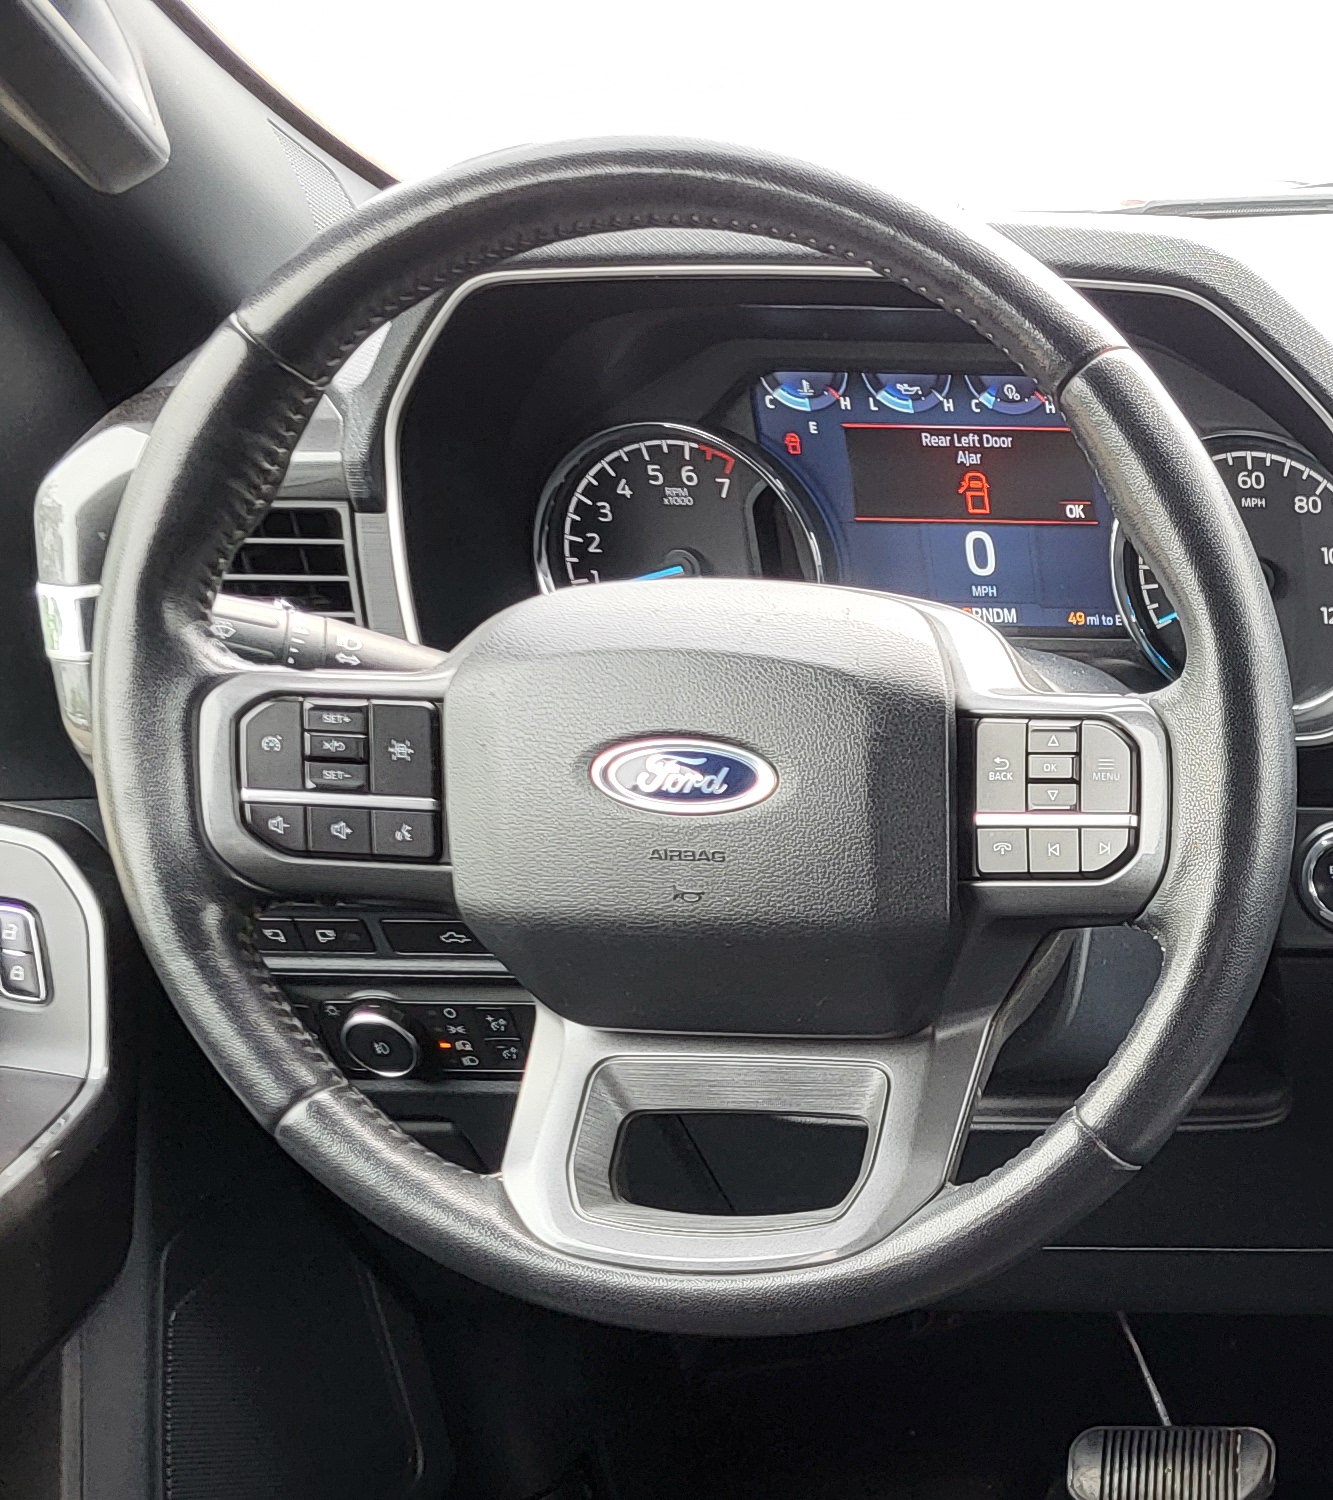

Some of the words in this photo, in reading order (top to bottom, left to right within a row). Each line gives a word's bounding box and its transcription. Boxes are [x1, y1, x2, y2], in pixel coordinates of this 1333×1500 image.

[765, 395, 775, 409] C
[840, 397, 851, 410] H
[869, 398, 878, 411] L
[943, 399, 954, 412] H
[971, 400, 980, 413] C
[1045, 401, 1056, 414] H
[809, 421, 818, 434] E
[921, 432, 950, 447] Rear
[954, 433, 980, 447] Left
[983, 434, 1013, 448] Door
[957, 451, 982, 466] Ajar
[647, 465, 664, 486] 5
[681, 465, 698, 486] 6
[1237, 471, 1265, 489] 60
[616, 478, 633, 499] 4
[664, 487, 688, 497] RPM
[715, 478, 731, 499] 7
[1241, 497, 1266, 508] MPH
[1294, 495, 1322, 514] 80
[595, 501, 613, 522] 3
[1065, 504, 1085, 518] OK
[585, 532, 603, 553] 2
[965, 531, 996, 577] 0
[972, 585, 997, 597] MPH
[1067, 611, 1085, 625] 49
[1086, 614, 1099, 625] mi
[1101, 614, 1113, 625] to
[636, 753, 729, 794] Ford
[1043, 763, 1058, 772] OK
[988, 771, 1013, 781] BACK
[1092, 771, 1121, 781] MENU
[649, 849, 726, 863] AIRBAG
